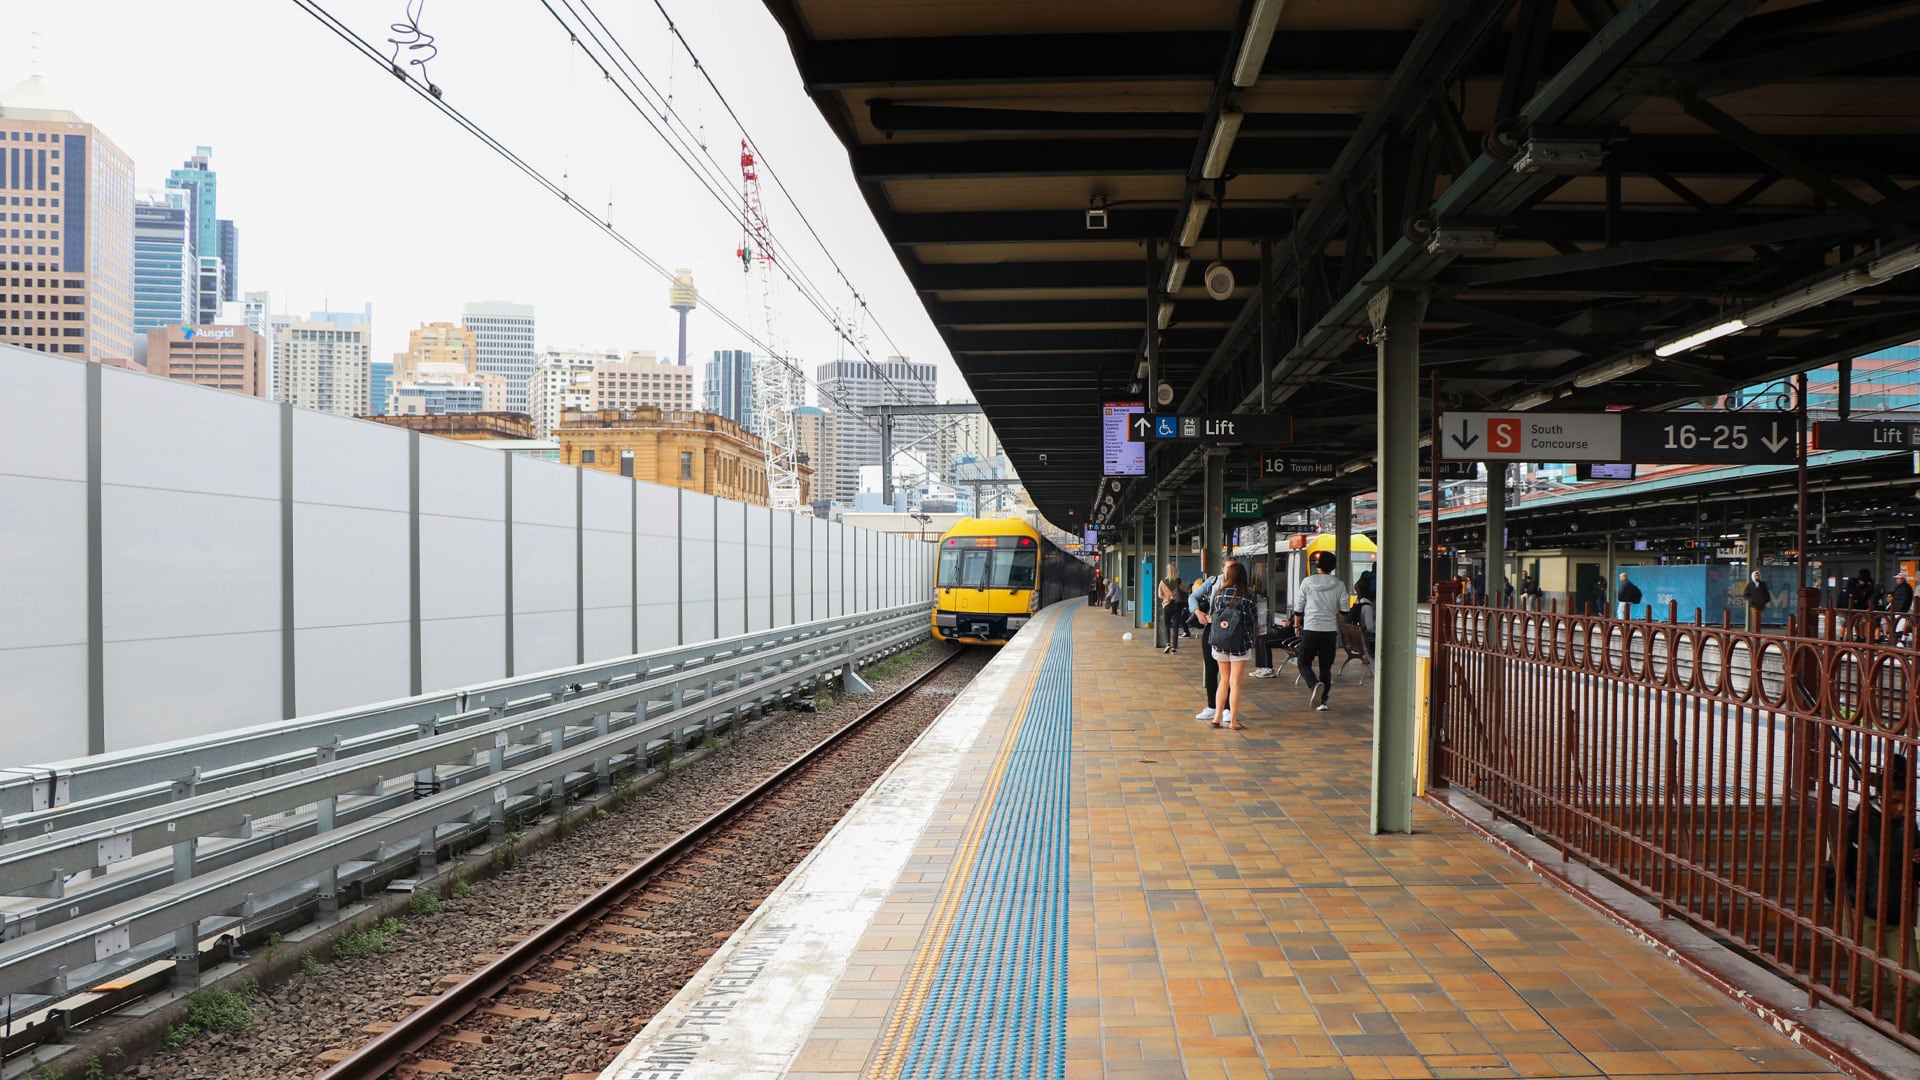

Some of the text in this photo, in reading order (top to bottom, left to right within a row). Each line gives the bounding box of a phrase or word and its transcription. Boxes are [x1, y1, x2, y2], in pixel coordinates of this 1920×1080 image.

[195, 328, 234, 339] Ausgrid
[1205, 419, 1235, 435] Lift
[1531, 424, 1563, 435] South
[1496, 423, 1513, 448] S
[1663, 424, 1748, 449] 16-25
[1873, 428, 1903, 443] Lift
[1531, 438, 1588, 449] Concourse
[1265, 458, 1284, 473] 16
[1290, 463, 1333, 472] Town Hall
[1231, 503, 1258, 513] HELP
[1719, 544, 1748, 555] CENTRA
[703, 946, 778, 998] YELLOW
[676, 1000, 738, 1028] THE
[630, 1032, 711, 1080] EHIND
